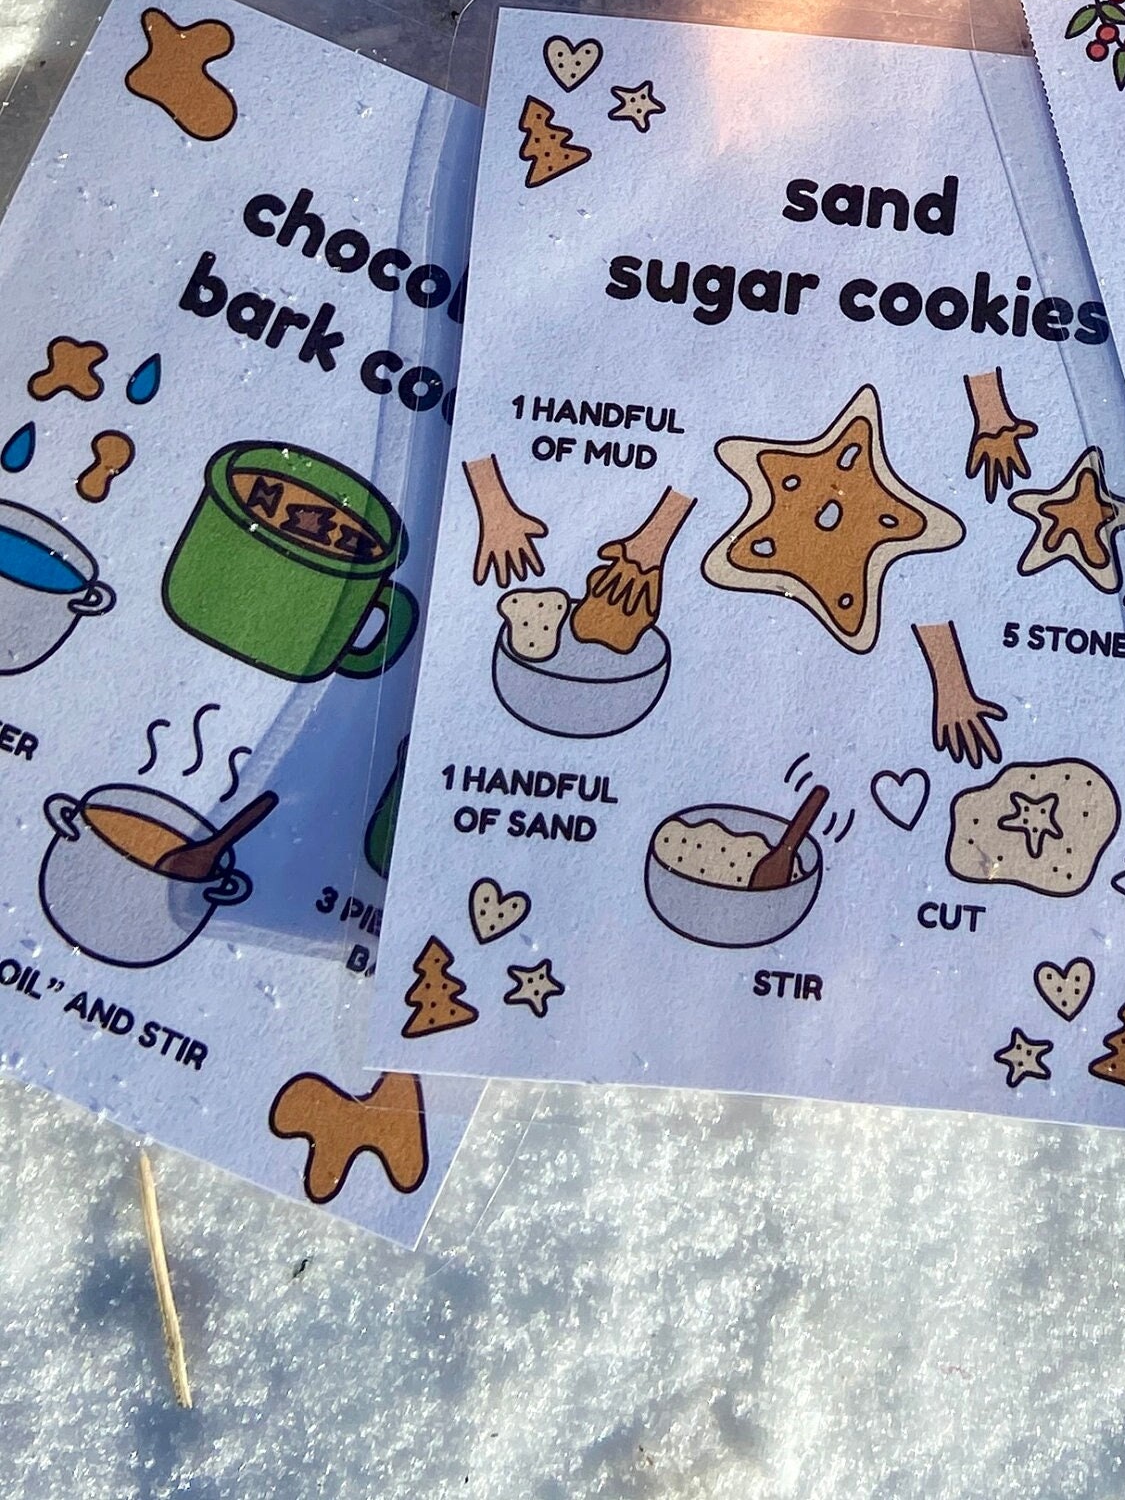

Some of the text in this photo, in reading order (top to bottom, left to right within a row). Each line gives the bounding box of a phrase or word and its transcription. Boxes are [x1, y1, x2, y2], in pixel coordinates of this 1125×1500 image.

[782, 176, 958, 236] sand
[179, 251, 345, 372] bark
[606, 256, 1110, 345] sugar cookies
[512, 395, 684, 434] 1 HANDFUL
[532, 436, 657, 469] OF MUD
[1003, 622, 1020, 648] 5
[0, 721, 38, 760] ER
[442, 764, 618, 803] 1 HANDFUL
[454, 808, 596, 842] OF SAND
[316, 887, 338, 914] 3
[918, 902, 986, 932] CUT
[753, 970, 822, 1001] STIR
[64, 992, 134, 1035] AND
[139, 1021, 207, 1070] STIR
